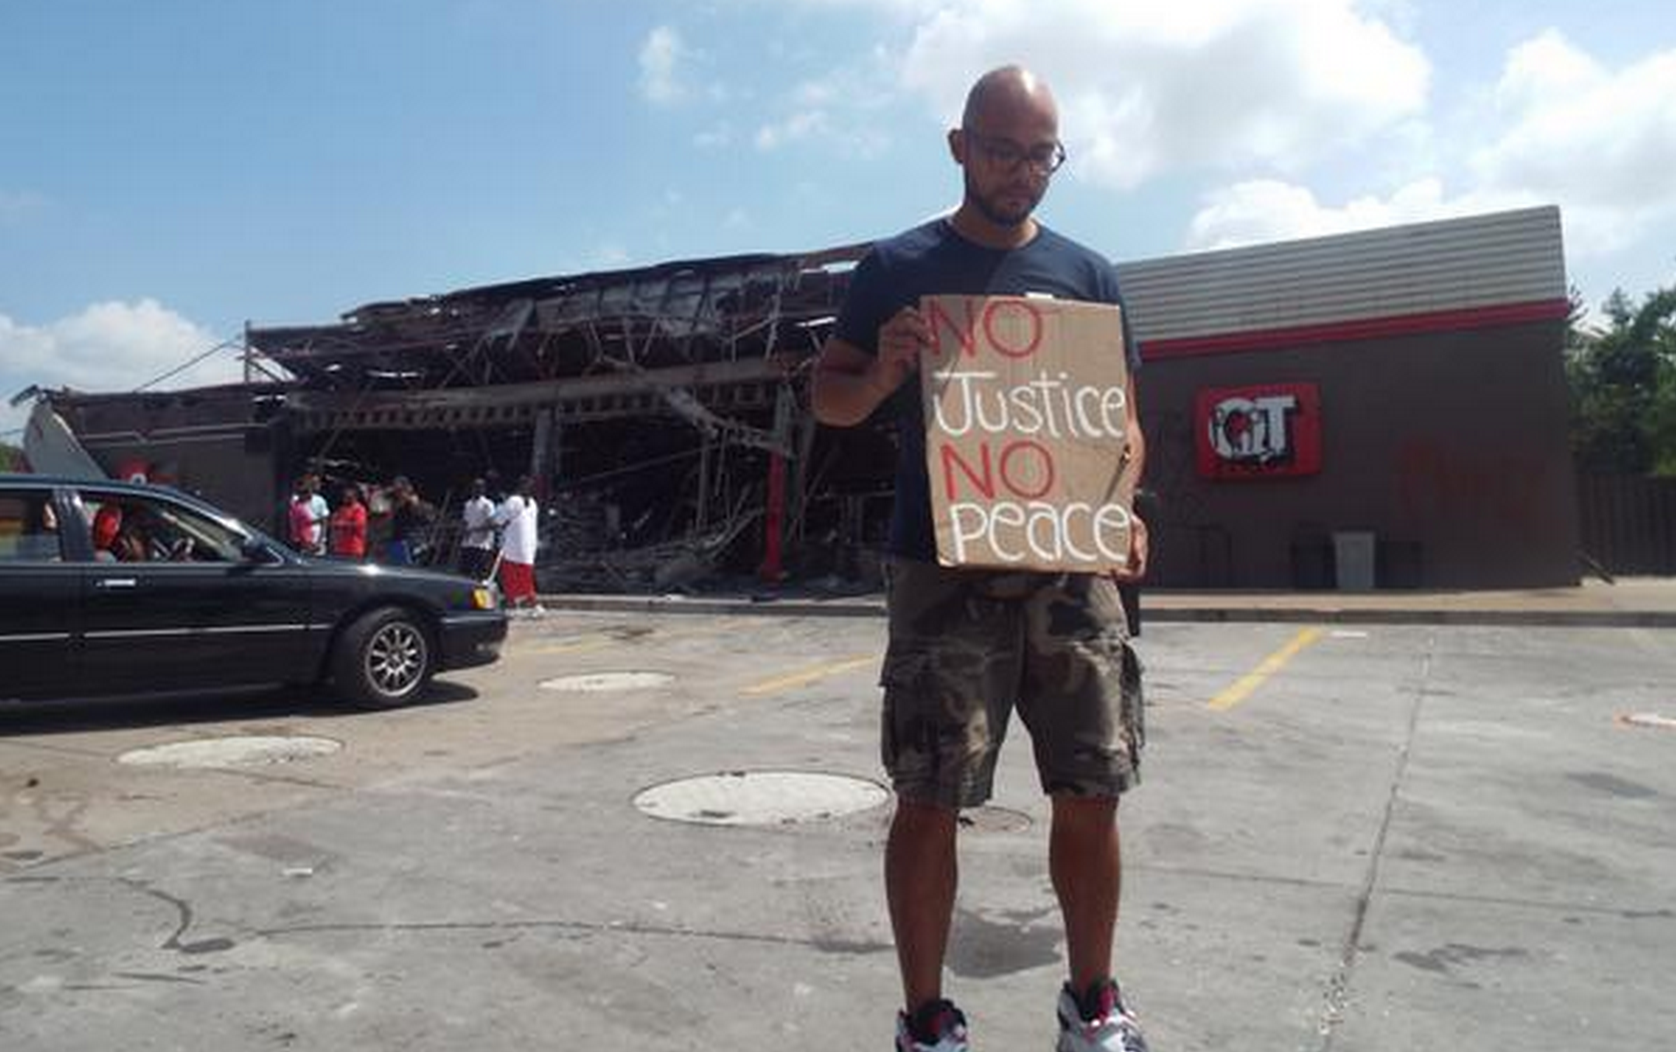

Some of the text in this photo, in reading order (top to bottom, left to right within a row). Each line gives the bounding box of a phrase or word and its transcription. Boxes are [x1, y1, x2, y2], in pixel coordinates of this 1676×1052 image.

[924, 297, 1043, 358] NO
[932, 370, 1126, 438] Justice
[940, 440, 1055, 500] NO
